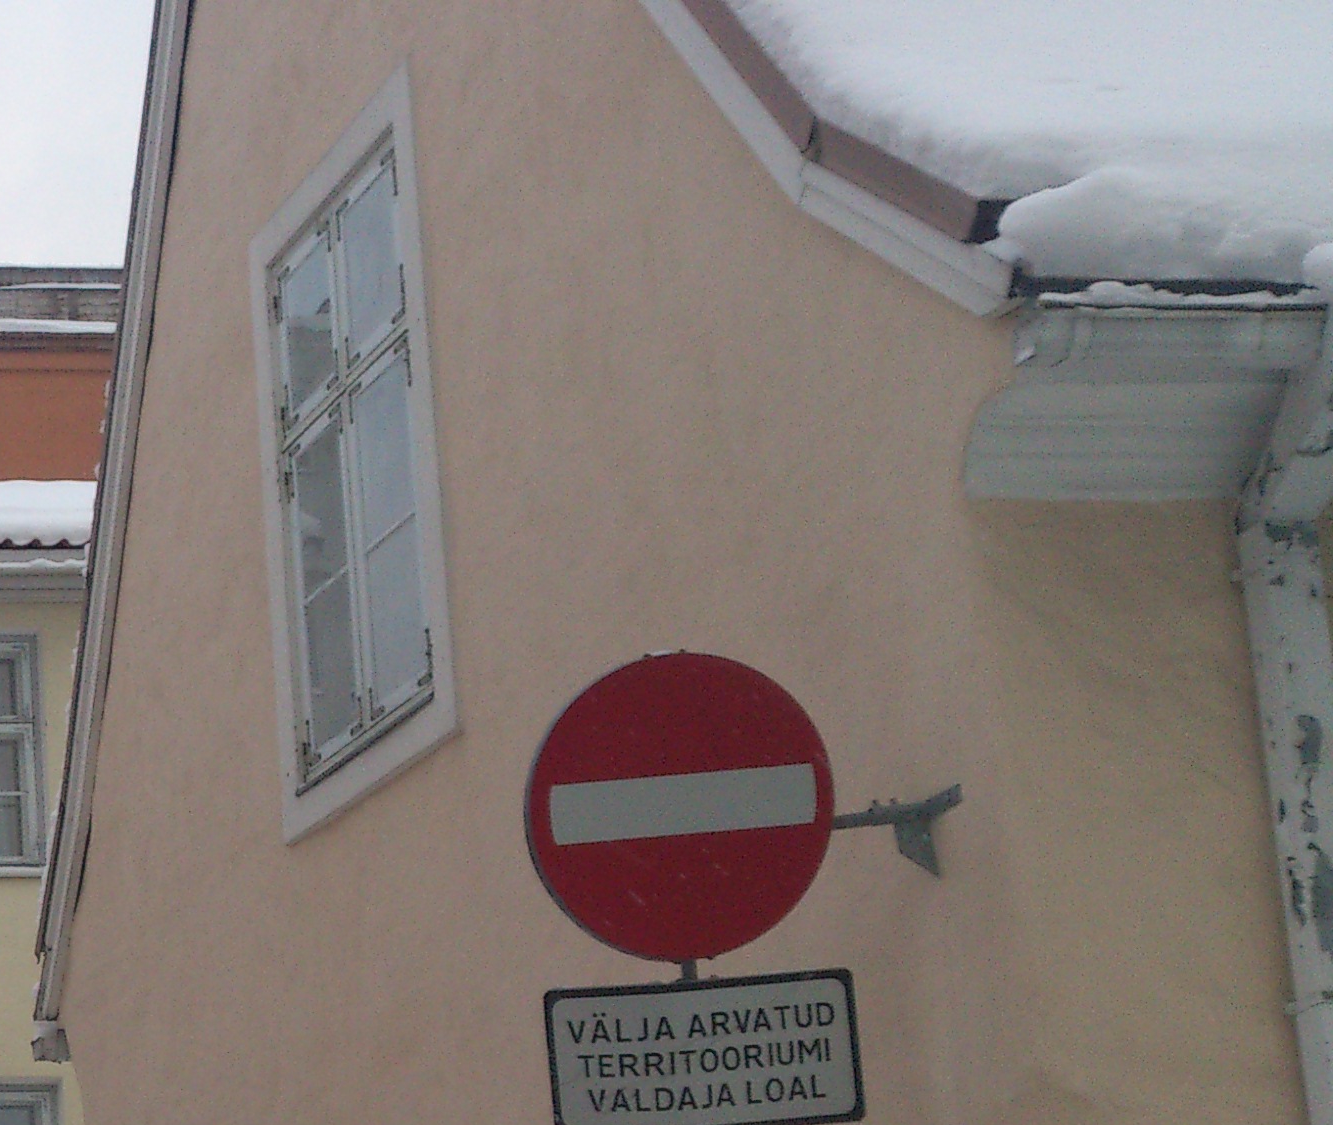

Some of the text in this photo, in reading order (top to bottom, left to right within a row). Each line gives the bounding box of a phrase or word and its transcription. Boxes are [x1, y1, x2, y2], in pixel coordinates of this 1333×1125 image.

[567, 1002, 835, 1044] VÄLJA ARVATUD
[577, 1037, 832, 1079] TERRITOORIUMI
[587, 1074, 827, 1113] VALDAJA LOAL
